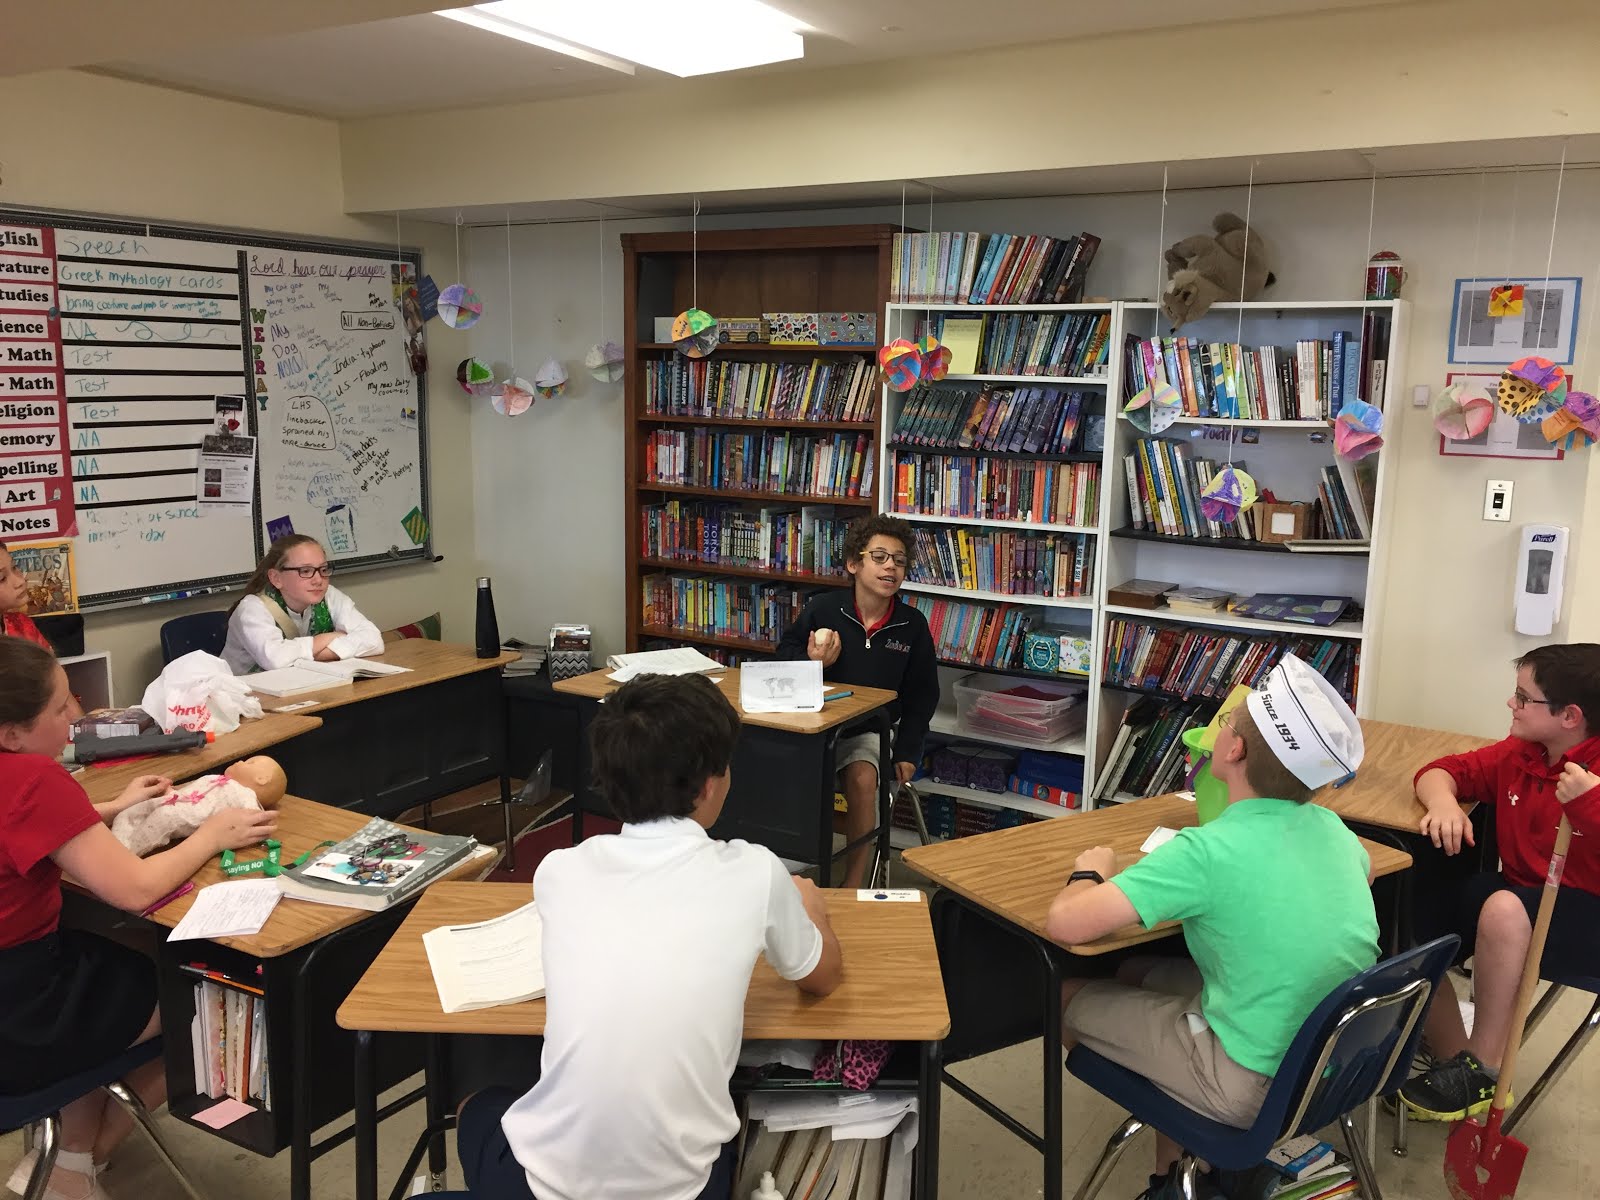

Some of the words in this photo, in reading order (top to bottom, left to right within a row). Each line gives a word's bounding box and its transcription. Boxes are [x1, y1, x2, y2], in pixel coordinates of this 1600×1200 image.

[64, 236, 150, 256] Speech
[61, 266, 104, 283] Greek
[109, 272, 172, 288] mythology
[179, 275, 224, 289] cards
[66, 295, 94, 313] bring
[66, 321, 98, 340] NA
[7, 348, 53, 362] Math
[71, 349, 113, 366] Test
[9, 376, 54, 391] Math
[75, 378, 110, 393] Test
[80, 404, 119, 420] Test
[291, 400, 312, 410] LHS
[335, 413, 357, 426] Joe
[77, 430, 101, 449] NA
[77, 456, 100, 476] NA
[5, 489, 36, 503] Art
[80, 484, 100, 502] NA
[1, 517, 51, 533] Notes
[710, 523, 718, 554] TORN
[1261, 693, 1279, 721] Since
[1275, 723, 1301, 751] 1934
[227, 863, 251, 874] saying
[250, 860, 265, 869] NO!
